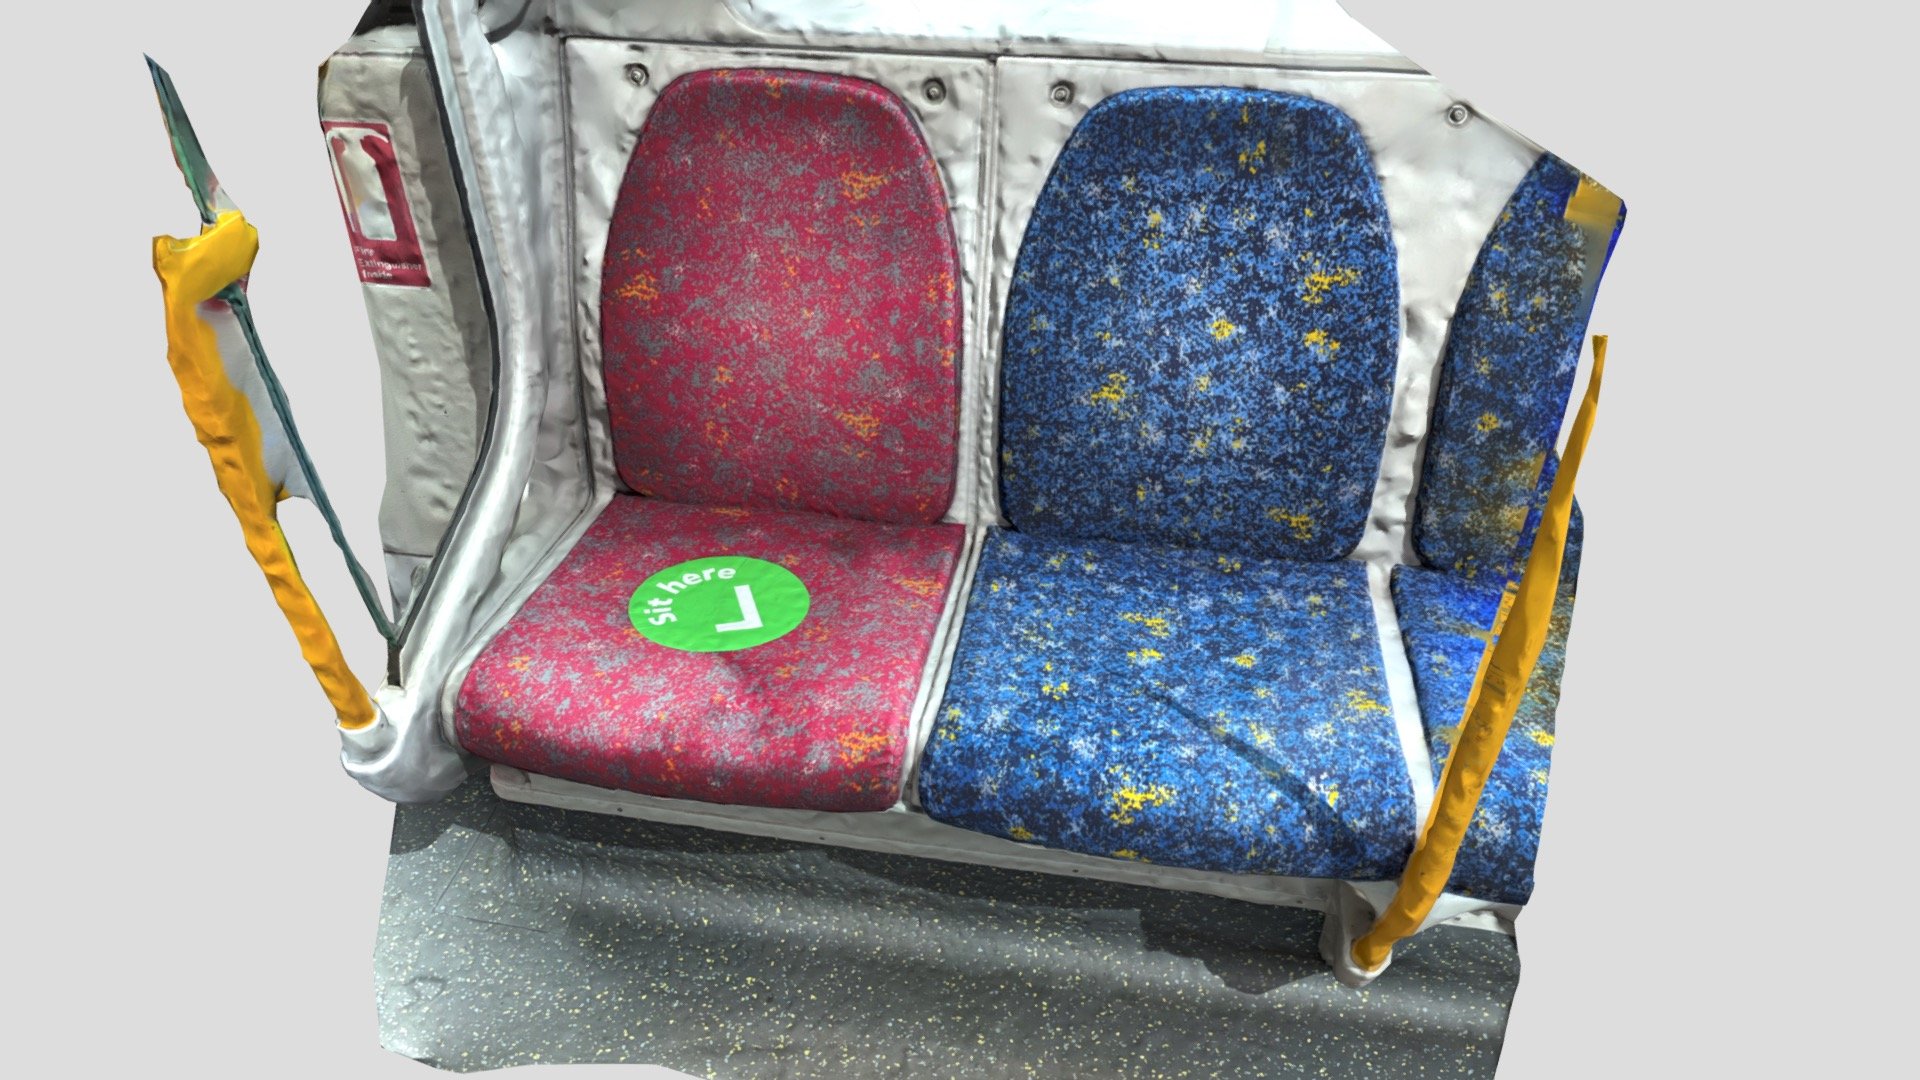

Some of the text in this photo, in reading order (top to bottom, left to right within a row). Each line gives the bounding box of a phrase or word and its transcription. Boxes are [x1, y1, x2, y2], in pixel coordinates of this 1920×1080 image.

[359, 258, 421, 271] Extinguisher
[643, 567, 736, 626] sit here
